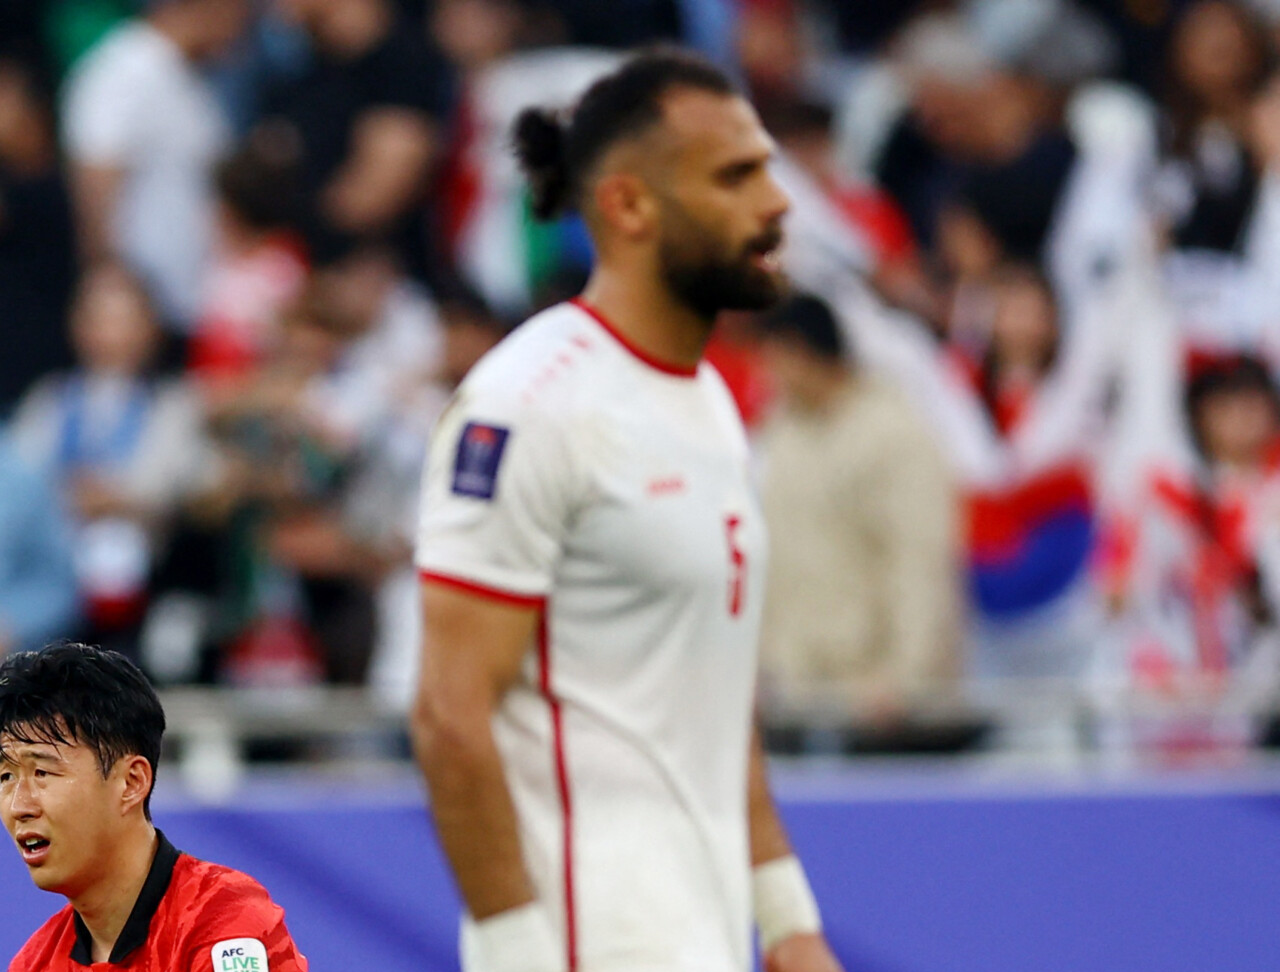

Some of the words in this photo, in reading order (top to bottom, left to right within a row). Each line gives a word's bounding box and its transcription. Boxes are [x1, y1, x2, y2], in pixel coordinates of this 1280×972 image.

[725, 513, 747, 618] 5
[221, 947, 245, 958] AFC
[222, 956, 261, 971] LIVE
